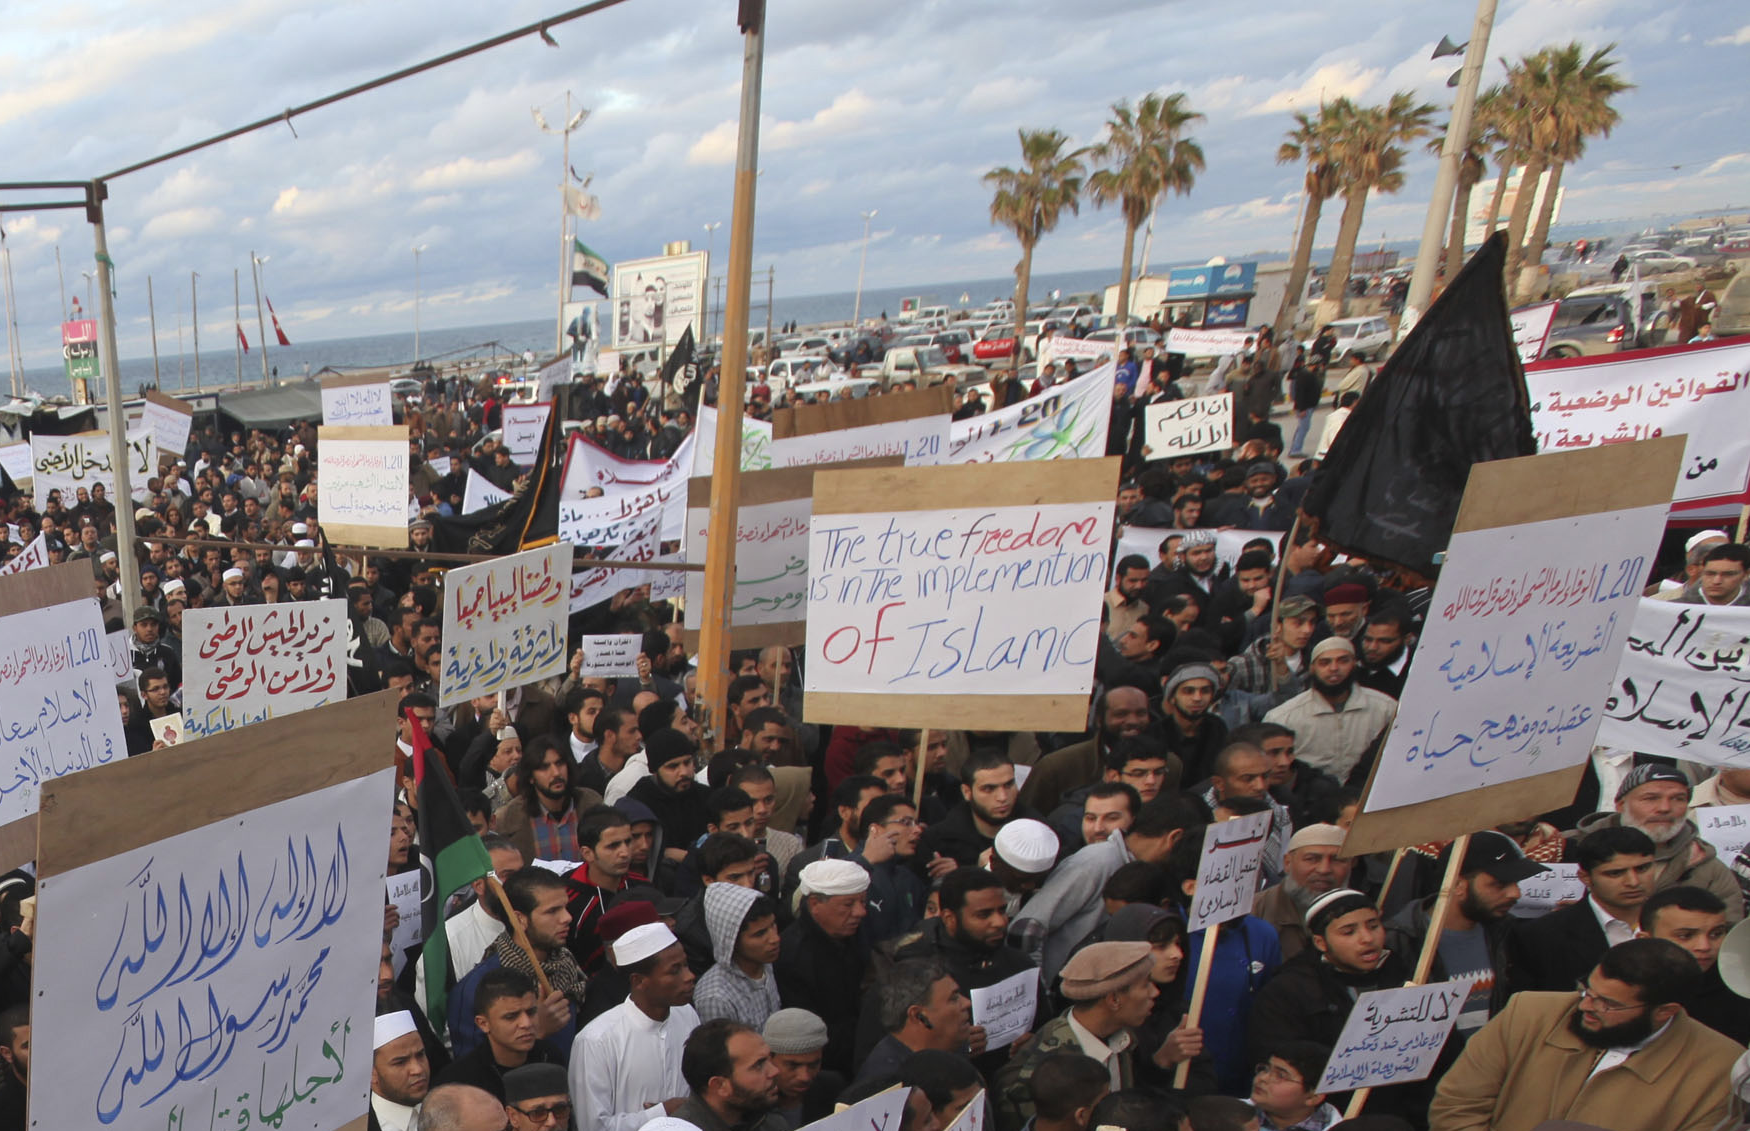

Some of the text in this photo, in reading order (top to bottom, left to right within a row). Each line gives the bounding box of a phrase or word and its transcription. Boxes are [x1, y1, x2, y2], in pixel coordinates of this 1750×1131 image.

[1549, 372, 1750, 417] القوانين الوضعية
[1686, 456, 1717, 480] من
[816, 512, 1101, 572] The true freedom
[488, 567, 516, 622] ليبيا
[837, 572, 861, 604] in
[1549, 611, 1618, 671] الشريعة
[1406, 711, 1473, 771] حياة
[297, 821, 349, 940] لا
[1432, 991, 1459, 1023] لا
[1380, 1037, 1398, 1052] ضد
